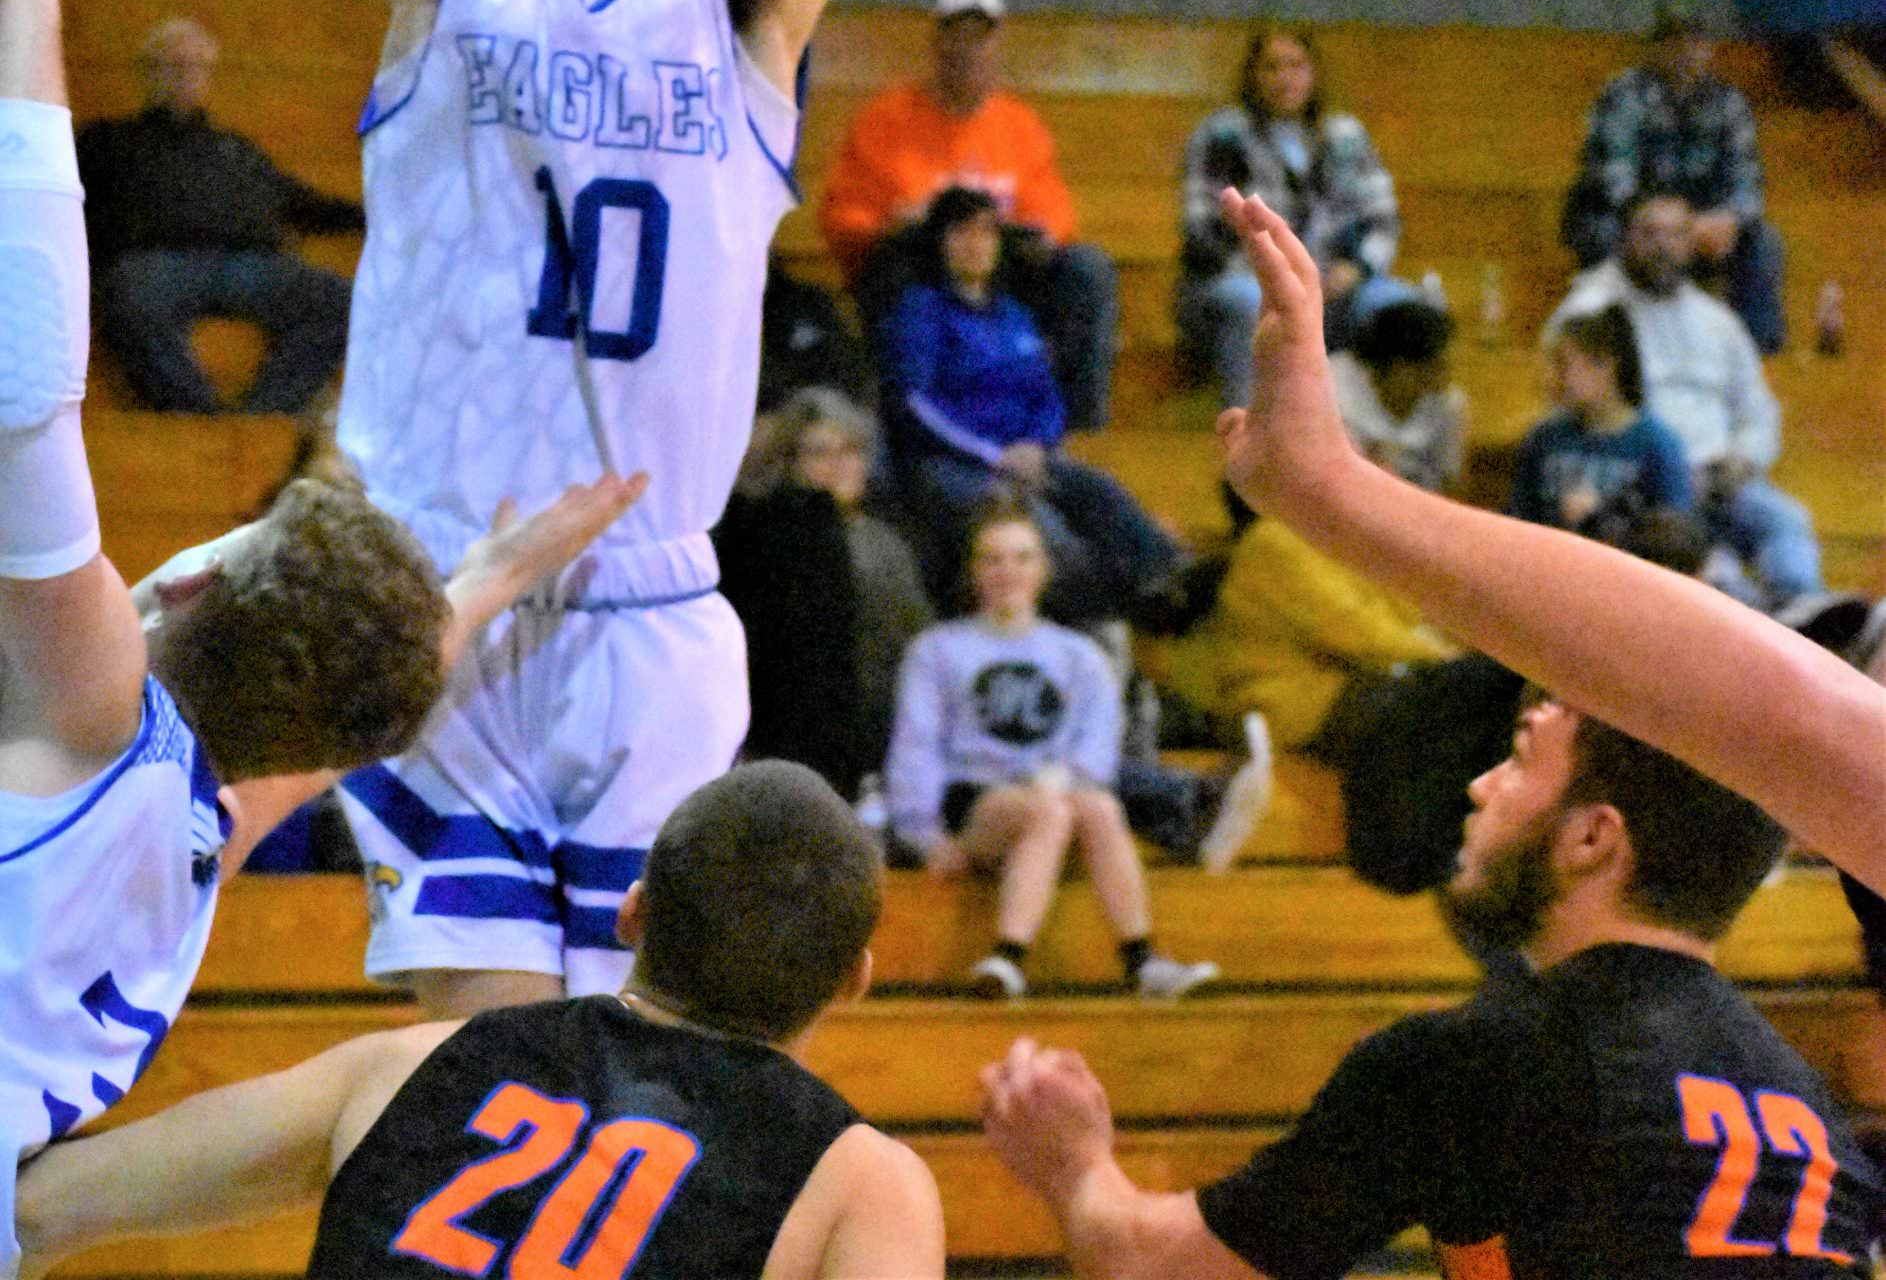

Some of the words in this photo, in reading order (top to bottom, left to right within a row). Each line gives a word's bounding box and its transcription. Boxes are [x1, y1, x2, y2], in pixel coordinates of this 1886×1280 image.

[526, 164, 671, 361] 10
[388, 1080, 704, 1280] 20
[1674, 1072, 1855, 1265] 22
